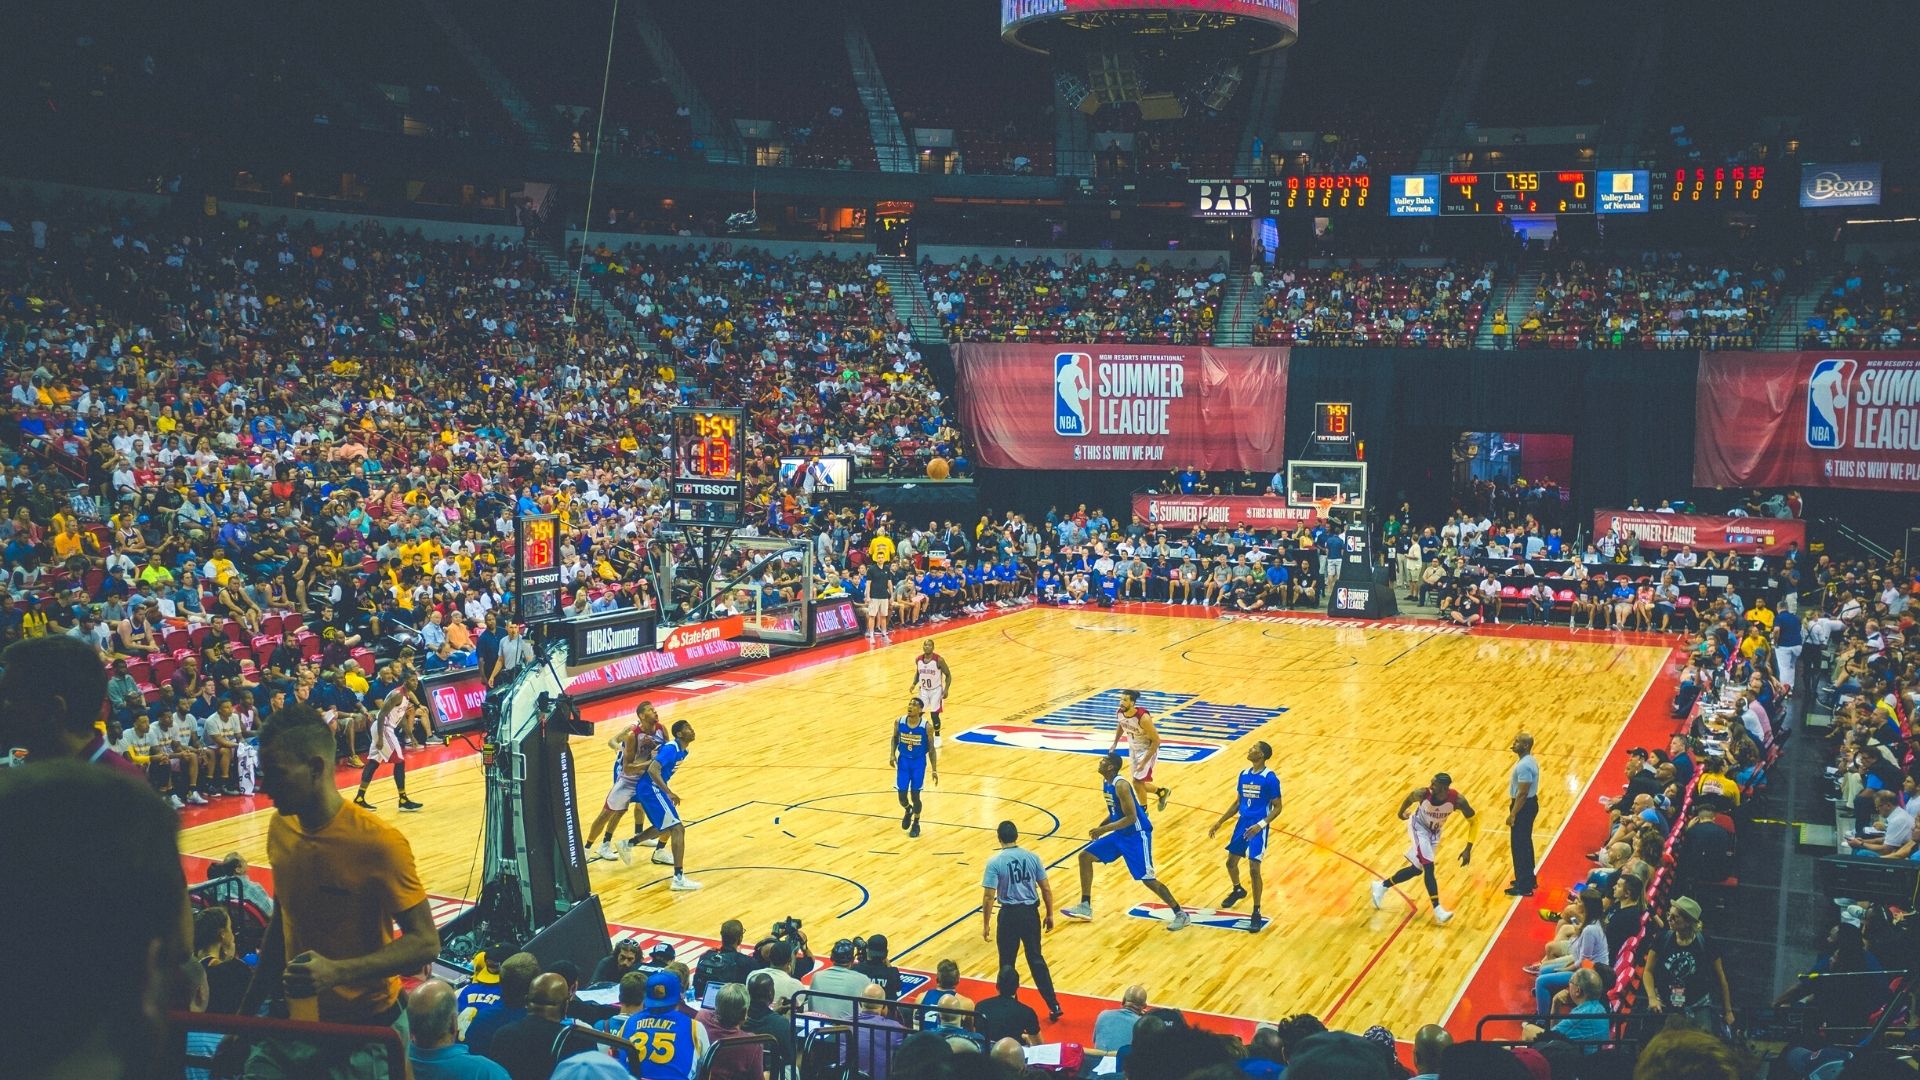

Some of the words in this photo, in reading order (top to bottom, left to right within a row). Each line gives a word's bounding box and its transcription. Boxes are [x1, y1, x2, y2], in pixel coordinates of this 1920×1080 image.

[1288, 177, 1299, 189] 10
[1306, 177, 1316, 189] 18
[1319, 177, 1334, 189] 20
[1337, 176, 1351, 189] 27
[1355, 176, 1369, 189] 40
[1506, 172, 1538, 189] 7:55
[1290, 189, 1297, 199] 2
[1325, 188, 1332, 198] 2
[1461, 185, 1471, 199] 4
[1575, 182, 1585, 199] 0
[1601, 194, 1623, 203] Valley
[1394, 197, 1414, 207] Valley
[1415, 197, 1435, 205] Bank
[1396, 205, 1406, 213] of
[1406, 204, 1432, 213] Nevada
[1497, 202, 1503, 212] 2
[1530, 201, 1537, 212] 2
[1559, 201, 1567, 211] 2
[1603, 202, 1613, 210] of
[1613, 201, 1641, 210] Nevada
[1098, 363, 1184, 398] SUMMER
[1856, 369, 1920, 407] SUMM
[694, 413, 736, 438] 7:54
[1060, 415, 1078, 430] NBA
[1098, 399, 1170, 435] LEAGUE
[1330, 416, 1345, 433] 13
[1811, 426, 1830, 442] NBA
[1854, 408, 1920, 450] LEAGU
[698, 440, 729, 477] 13
[1082, 445, 1101, 460] THIS
[1103, 445, 1111, 460] IS
[1112, 445, 1131, 460] WHY
[1132, 445, 1144, 460] WE
[1145, 445, 1164, 460] PLAY
[1834, 460, 1855, 477] THIS
[1857, 461, 1866, 478] IS
[1868, 461, 1889, 479] WHY
[1890, 462, 1904, 480] WE
[1905, 463, 1920, 481] PLA
[693, 484, 738, 495] TISSOT
[1160, 506, 1197, 522] SUMMER
[1199, 507, 1230, 523] LEAGUE
[1252, 508, 1265, 519] THIS
[1273, 508, 1286, 520] WHY
[1296, 509, 1311, 521] PLAY
[1622, 523, 1661, 542] SUMMER
[1662, 526, 1697, 545] LEAGUE
[1726, 526, 1775, 537] #NBASummer
[535, 542, 548, 566] 13
[533, 573, 560, 584] TISSOT
[586, 627, 640, 655] #NBASummer
[613, 656, 651, 680] SUMMER
[649, 651, 679, 675] LEAGUE
[686, 647, 704, 661] MGM
[705, 641, 737, 656] RESORTS
[921, 678, 932, 689] 20
[443, 693, 459, 715] TV
[562, 772, 571, 807] RESORTS
[565, 808, 577, 867] INTERNATIONAL
[636, 1017, 677, 1030] DURANT
[630, 1031, 677, 1064] 35
